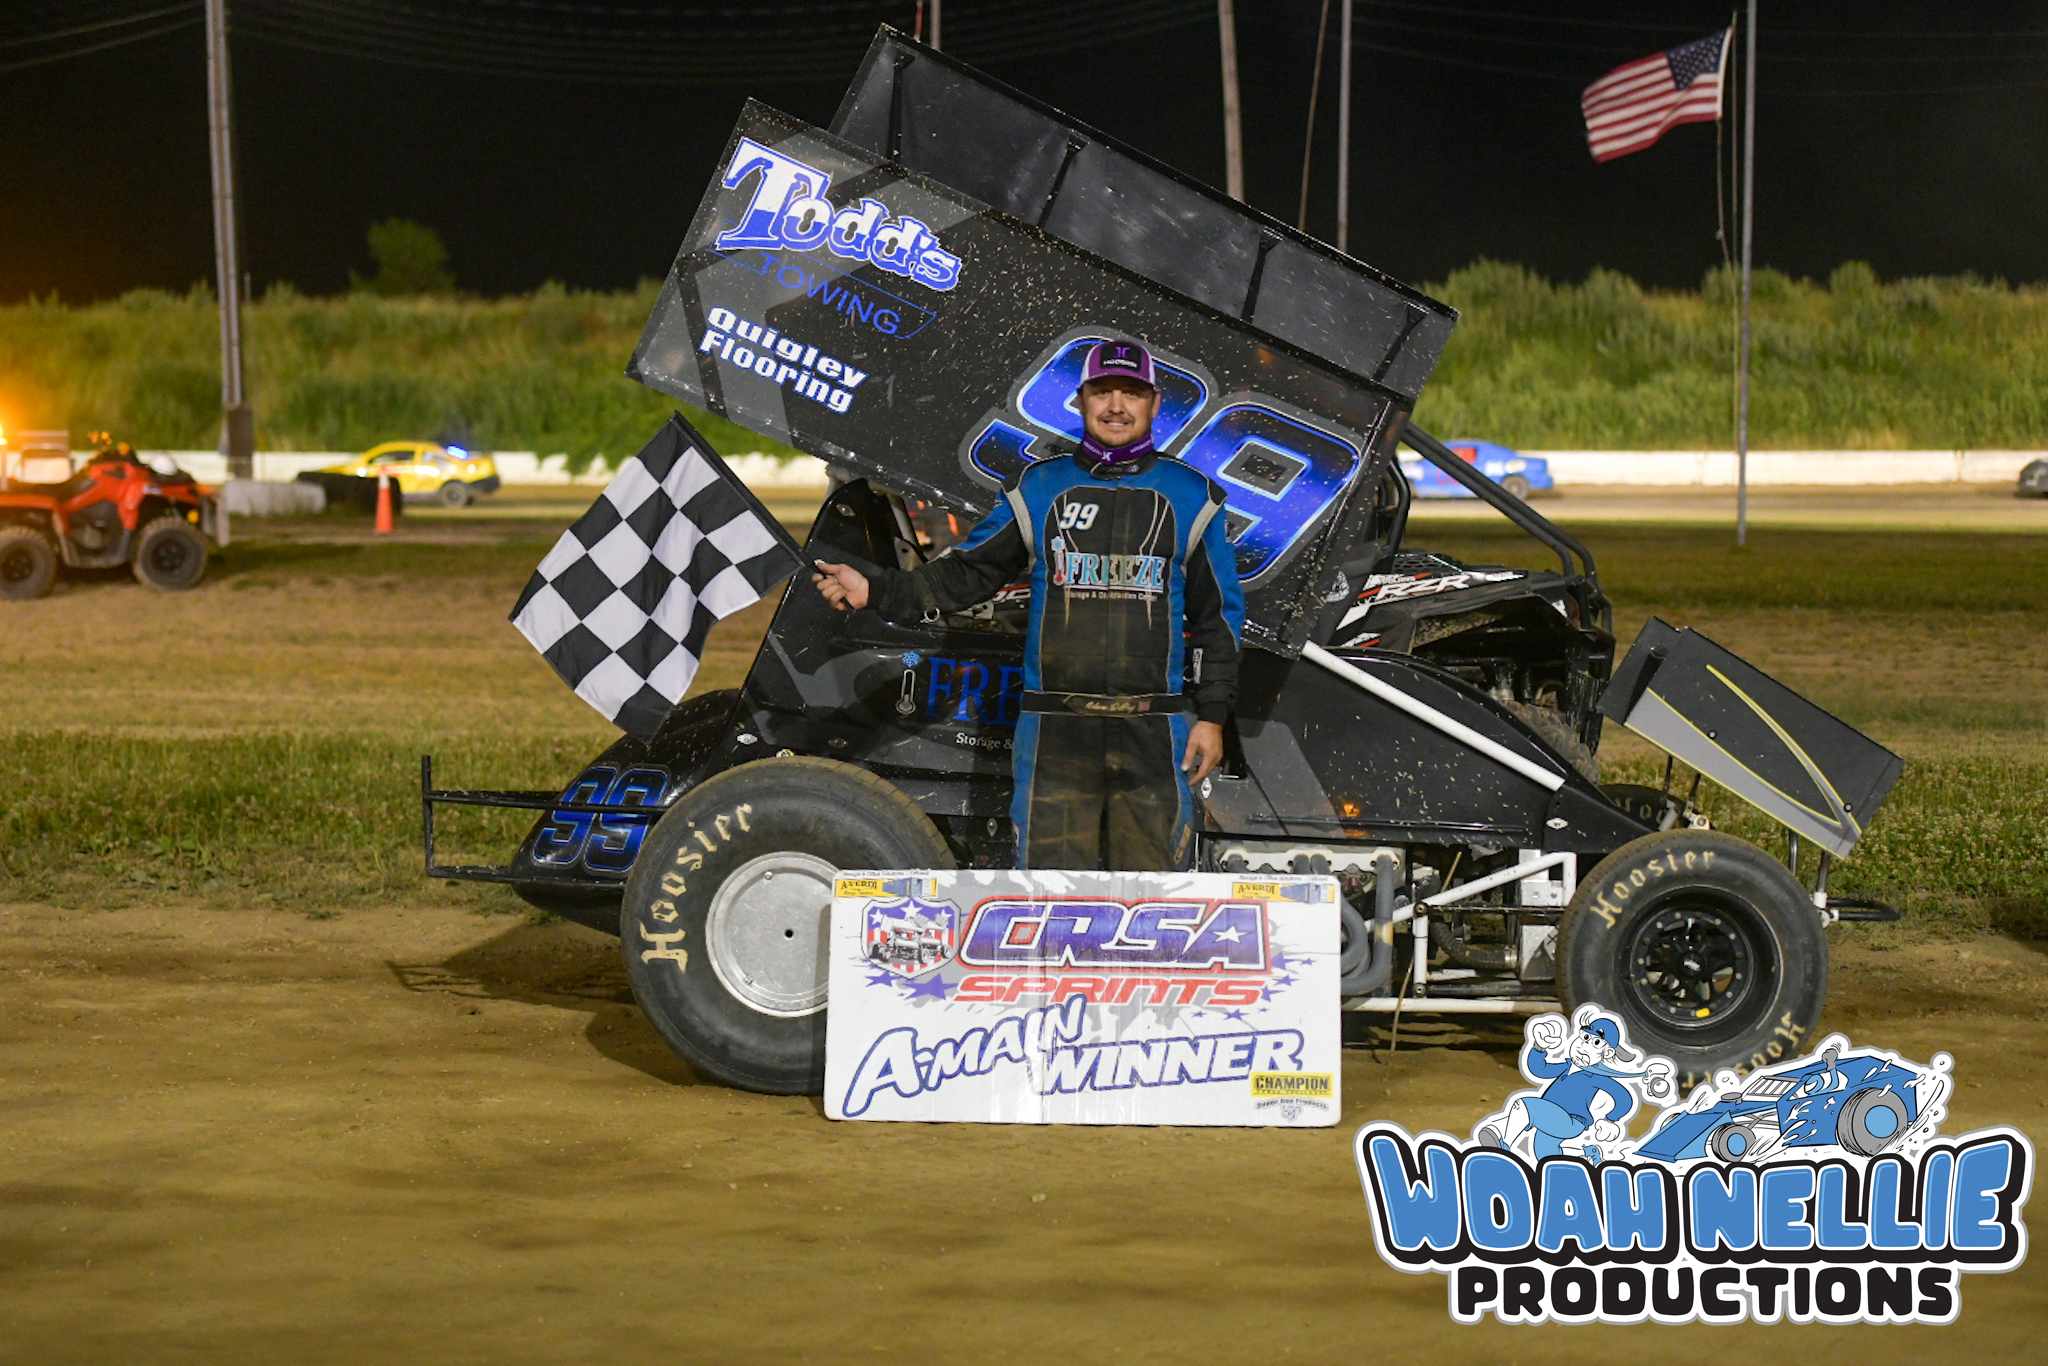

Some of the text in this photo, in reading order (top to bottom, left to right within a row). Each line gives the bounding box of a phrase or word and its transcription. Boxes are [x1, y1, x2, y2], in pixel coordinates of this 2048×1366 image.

[715, 136, 962, 291] Todd's
[756, 251, 902, 336] TOWING
[699, 329, 854, 414] Flooring
[706, 306, 869, 389] Quigley
[1058, 501, 1100, 531] 99
[1063, 551, 1167, 590] FREEZE
[1376, 574, 1472, 600] RZR
[955, 731, 1001, 750] Storage
[530, 765, 672, 873] 99
[639, 801, 753, 975] Hoosier
[1590, 848, 1716, 930] Hoosier
[961, 900, 1270, 971] CRSA
[952, 974, 1267, 1006] SPRINTS
[1034, 1029, 1306, 1097] WINNER
[1256, 1075, 1330, 1091] CHAMPION
